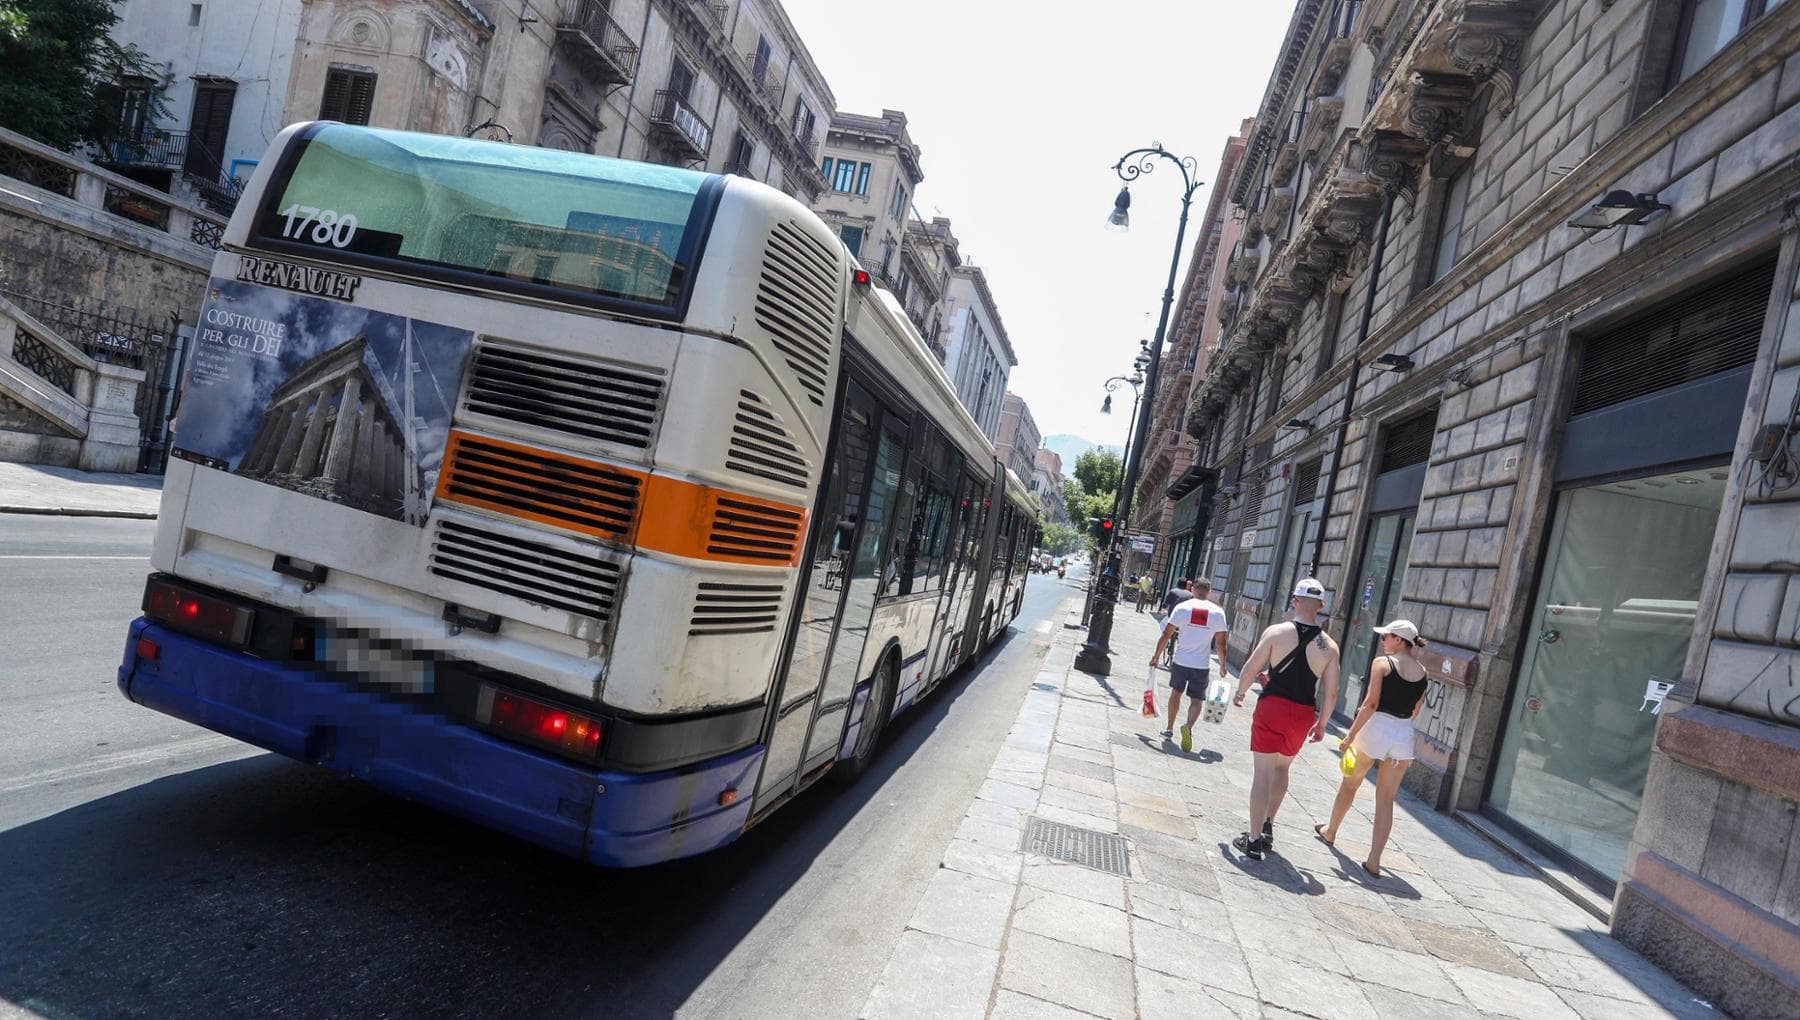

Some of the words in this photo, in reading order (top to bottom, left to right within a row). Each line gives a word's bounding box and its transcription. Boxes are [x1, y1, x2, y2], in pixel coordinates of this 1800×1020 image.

[281, 203, 358, 248] 1780
[237, 255, 361, 302] RENAULT
[207, 308, 286, 338] COSTRUIRE
[202, 328, 224, 344] PER
[228, 334, 249, 349] GLI
[252, 334, 283, 358] DEI
